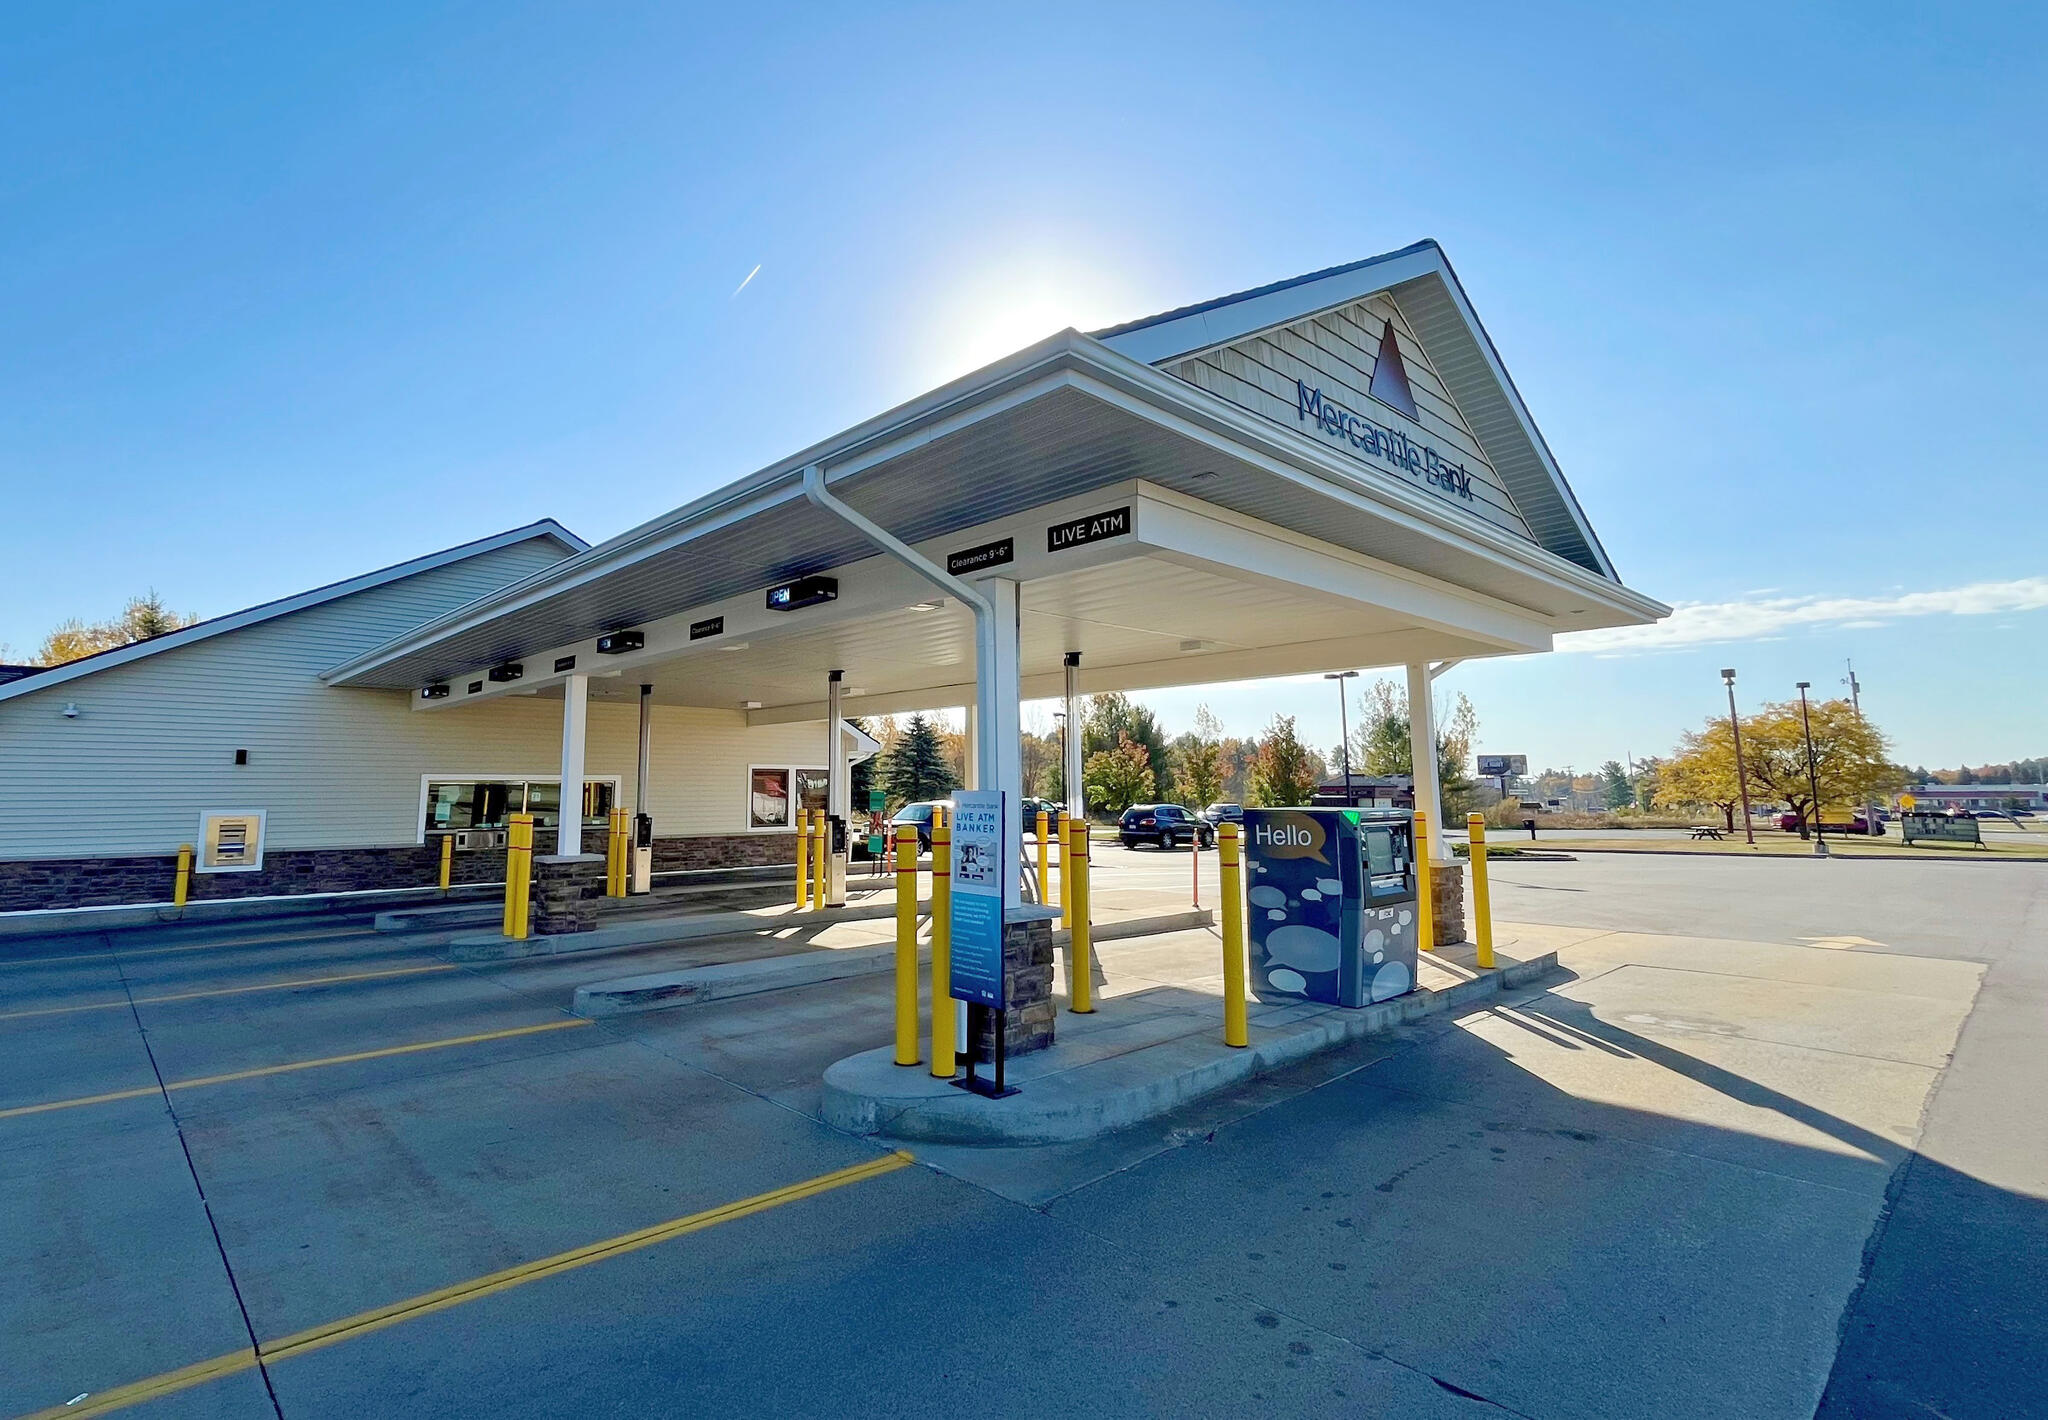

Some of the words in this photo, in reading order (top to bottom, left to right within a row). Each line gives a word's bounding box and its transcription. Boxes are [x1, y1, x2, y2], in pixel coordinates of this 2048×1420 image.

[1297, 378, 1421, 477] Mercantile
[1425, 446, 1474, 502] Bank
[1053, 524, 1086, 546] LIVE
[1090, 514, 1124, 536] ATM
[951, 553, 988, 569] Clearance
[769, 587, 790, 604] OPEN
[956, 812, 974, 822] LIVE
[978, 813, 995, 823] ATM
[956, 823, 995, 833] BANKER
[1255, 824, 1313, 846] Hello
